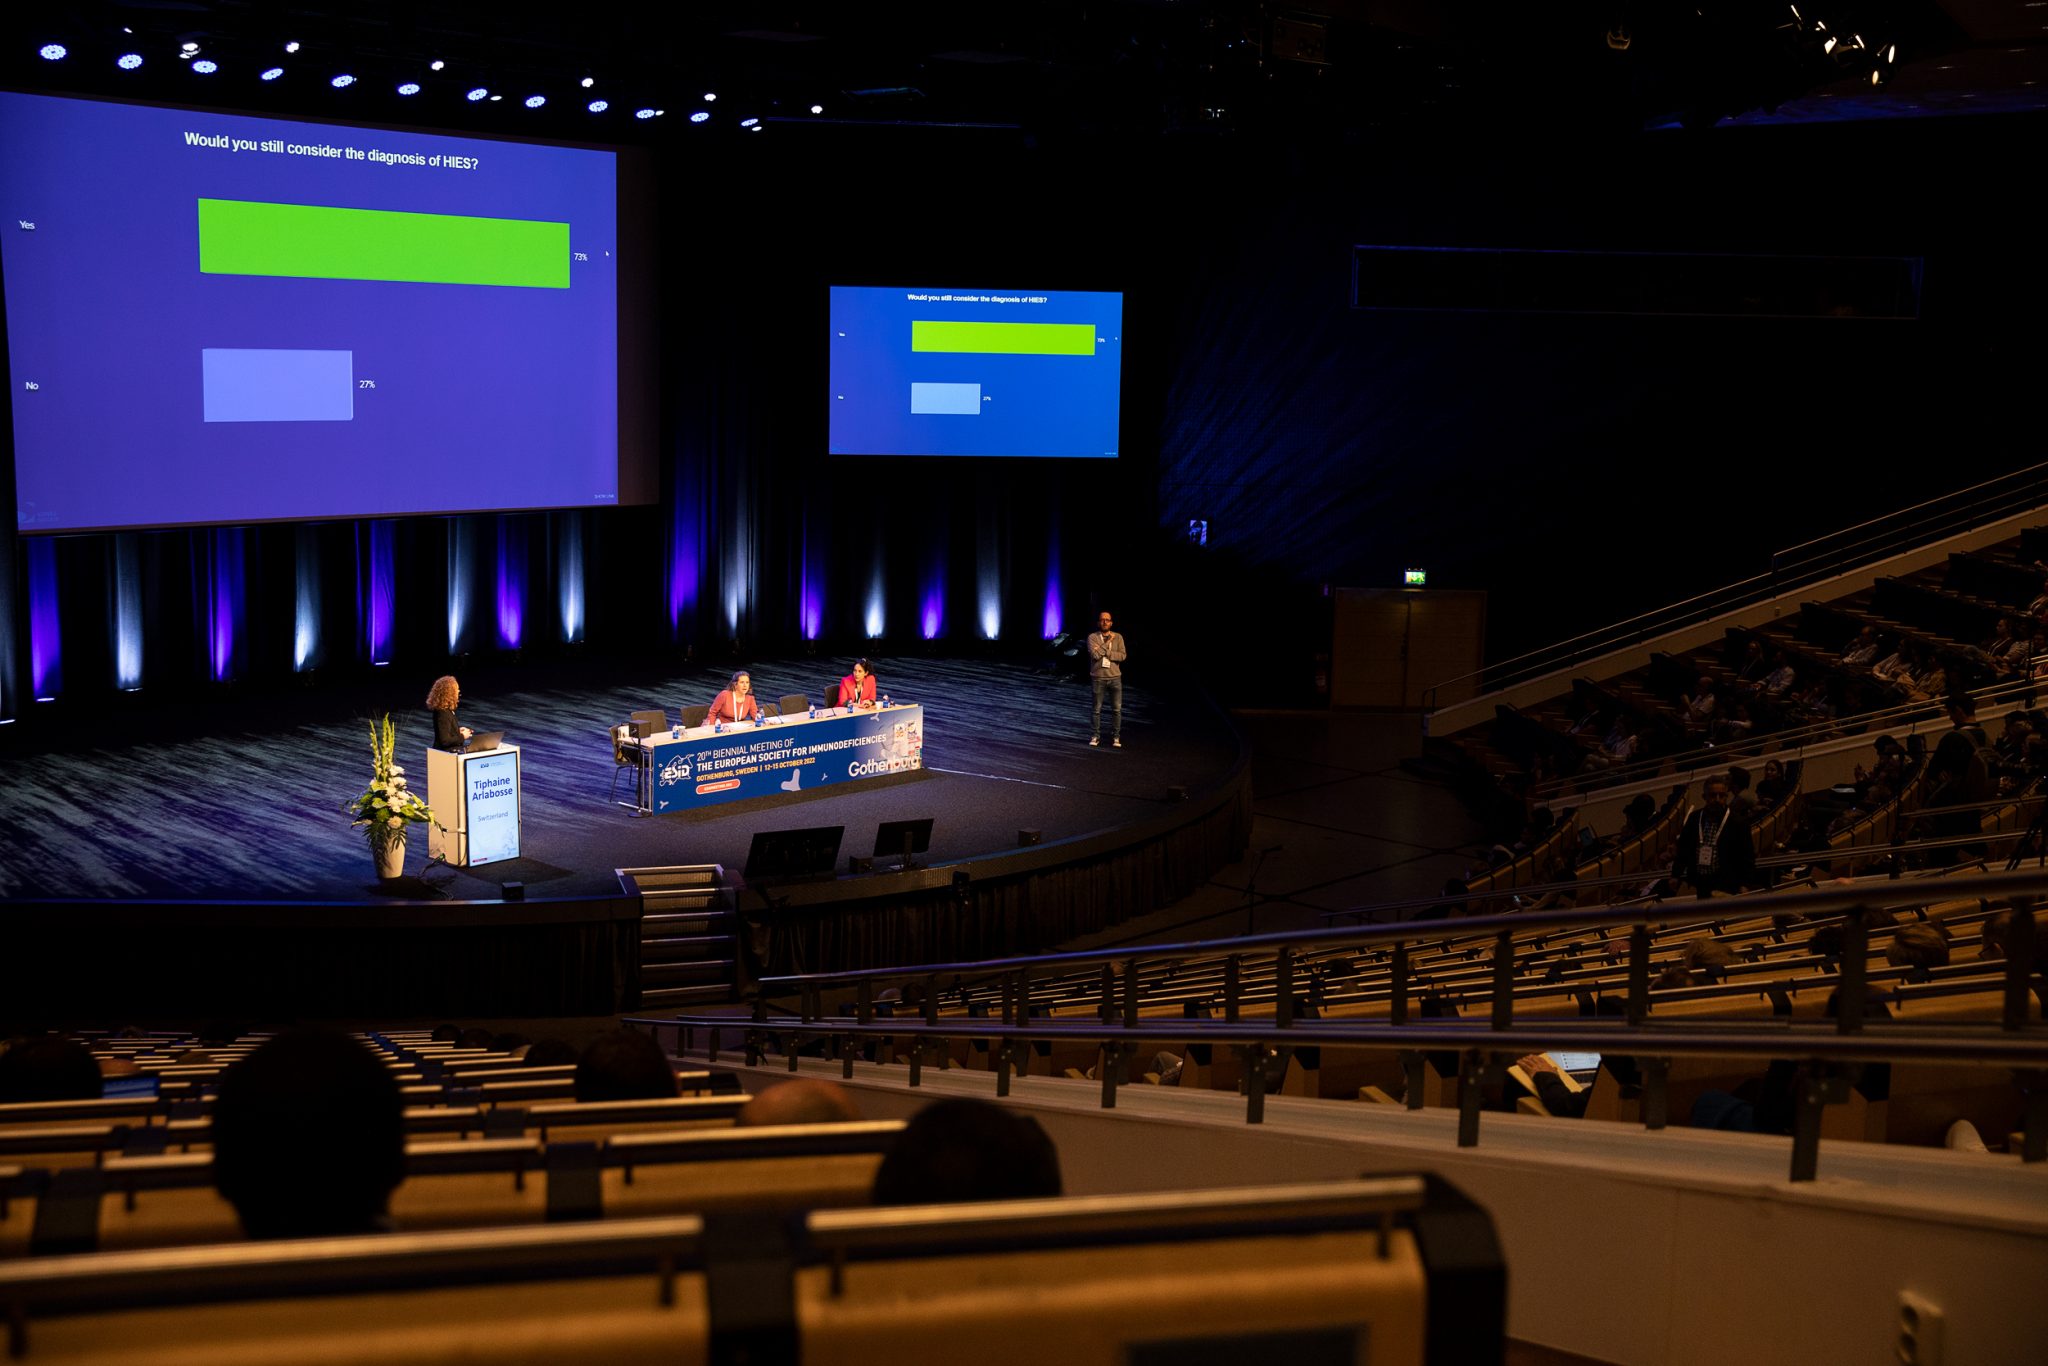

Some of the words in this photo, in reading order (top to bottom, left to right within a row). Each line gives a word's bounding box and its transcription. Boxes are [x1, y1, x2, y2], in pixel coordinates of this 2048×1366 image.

[184, 131, 229, 148] Would
[232, 139, 257, 152] you
[260, 140, 284, 153] still
[287, 144, 343, 158] consider
[345, 147, 365, 160] the
[368, 149, 426, 166] diagnosis
[428, 155, 441, 167] of
[443, 156, 479, 170] HIES?
[19, 220, 36, 230] Yes
[574, 252, 588, 261] 73%
[26, 381, 39, 390] No
[360, 380, 376, 389] 27%
[697, 761, 713, 772] THE
[714, 754, 757, 769] EUROPEAN
[758, 749, 791, 762] SOCIETY
[792, 746, 807, 757] FOR
[808, 734, 887, 754] IMMUNODEFICIENCIES
[713, 745, 748, 759] BIENNIAL
[750, 740, 782, 753] MEETING
[784, 738, 794, 748] OF
[735, 765, 759, 776] SWEDEN
[779, 759, 803, 769] OCTOBER
[848, 756, 921, 777] Gothenburg
[474, 777, 511, 790] Tiphaine
[472, 787, 513, 801] Arlabosse
[478, 811, 509, 822] Switzerland
